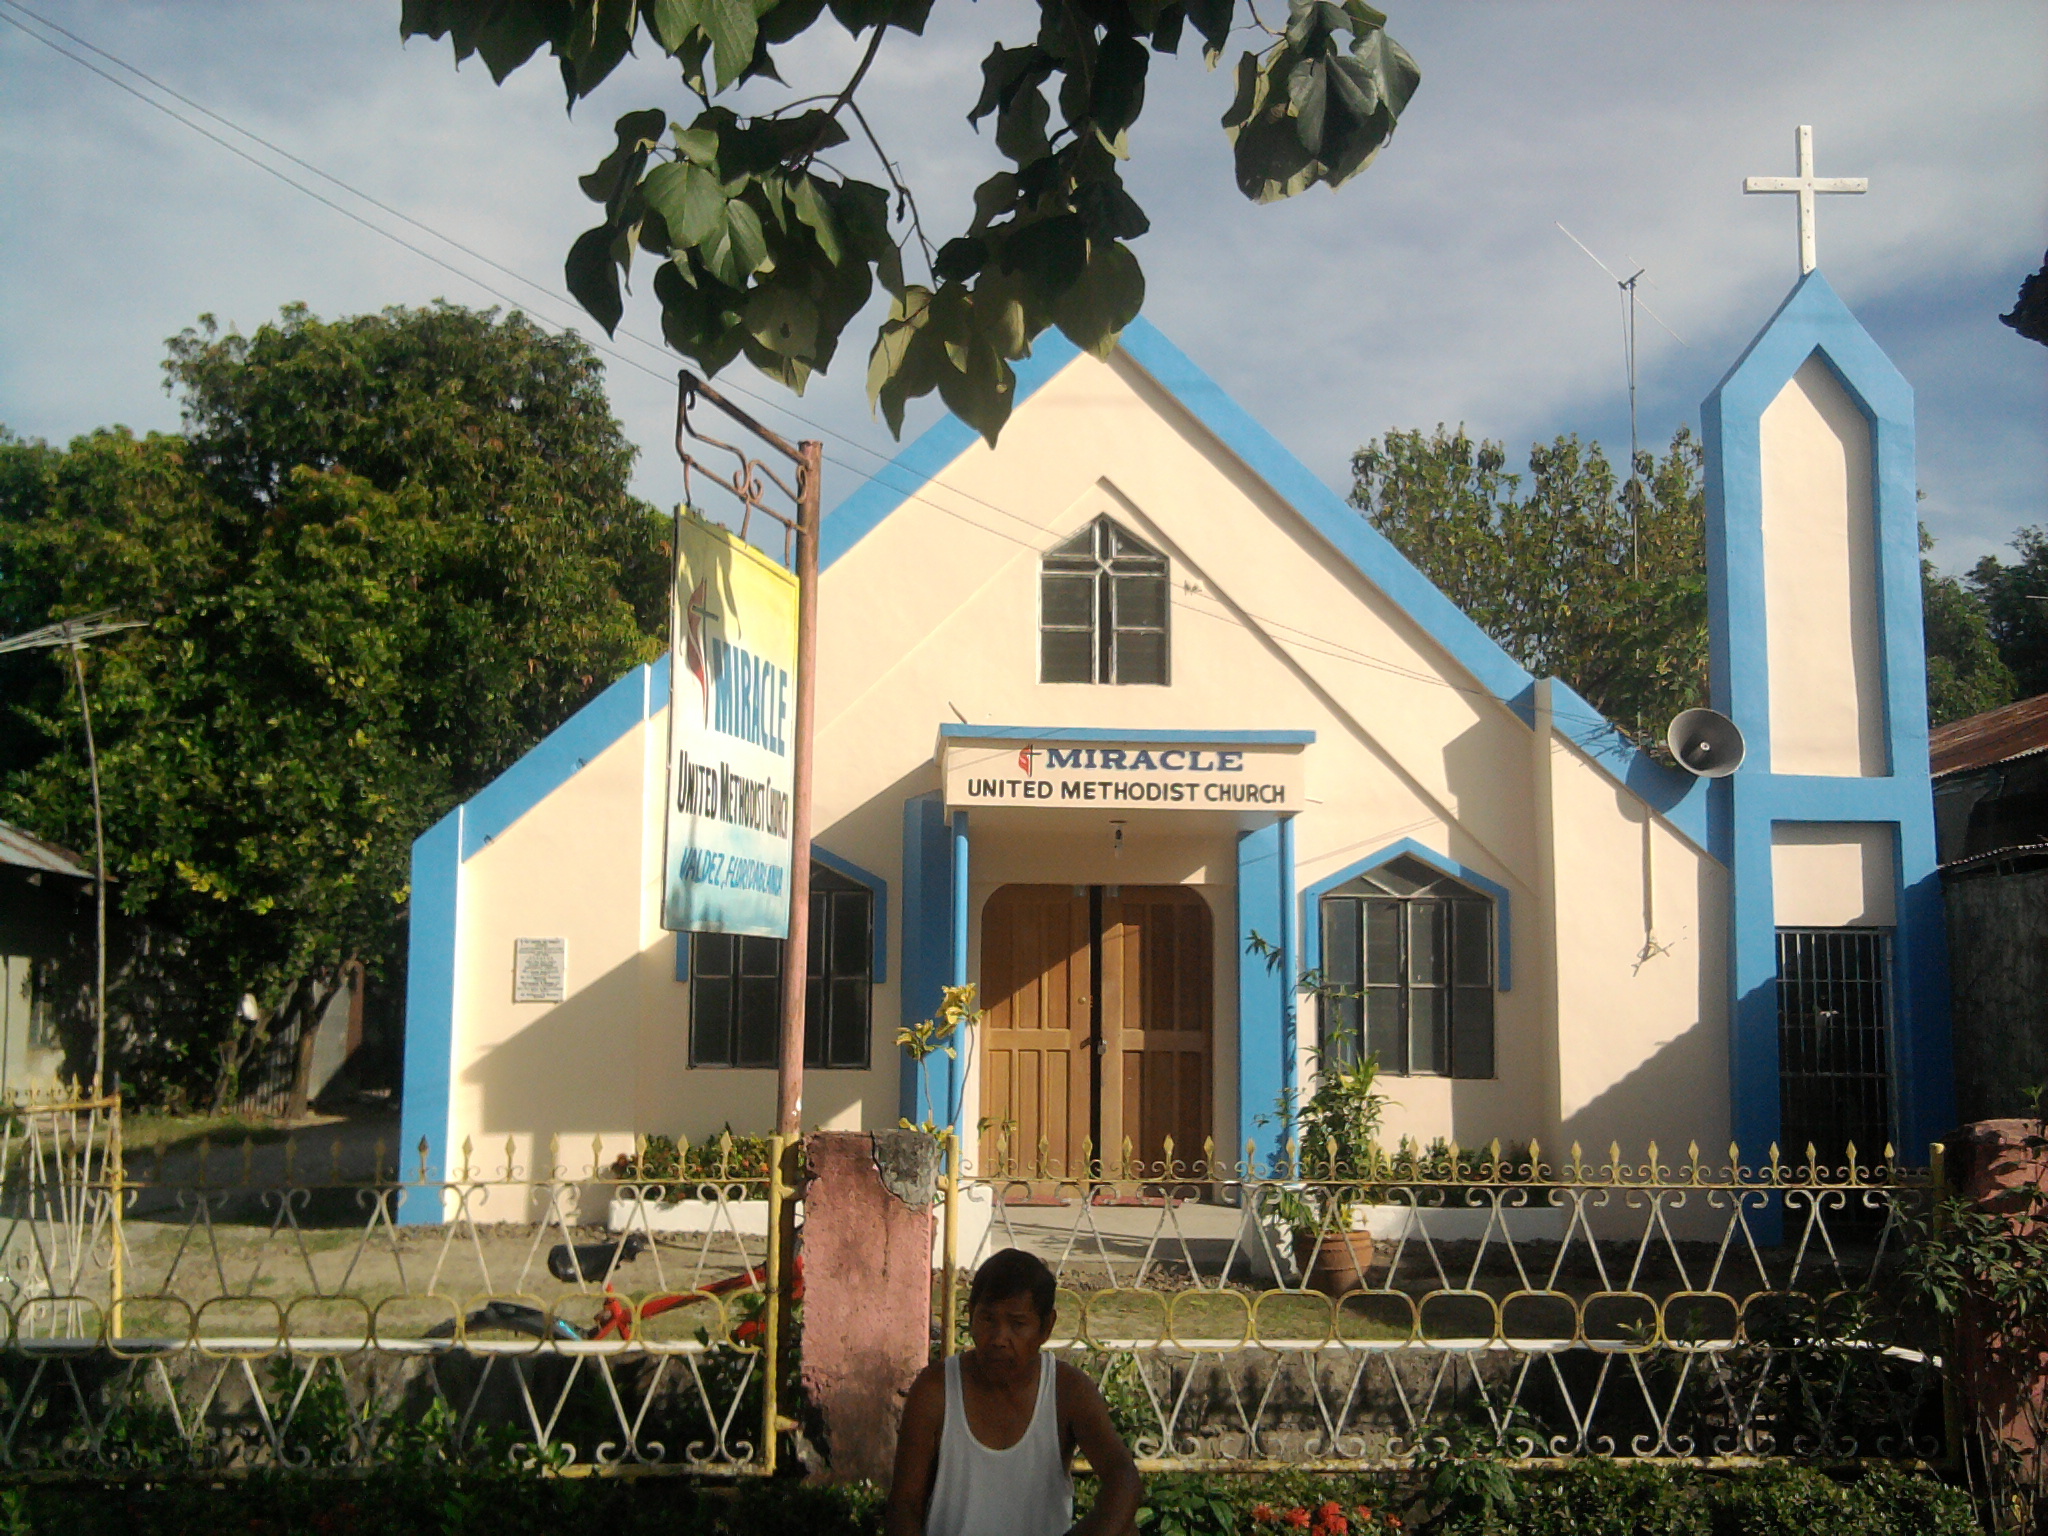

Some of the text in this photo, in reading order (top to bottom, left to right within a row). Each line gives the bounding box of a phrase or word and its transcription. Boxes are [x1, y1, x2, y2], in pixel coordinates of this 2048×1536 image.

[712, 637, 788, 757] MIRACLE
[1046, 748, 1244, 772] MIRACLE
[677, 749, 718, 819] UNITED
[719, 760, 765, 832] METHODIST
[967, 778, 1286, 804] UNITED METHODIST CHURCH
